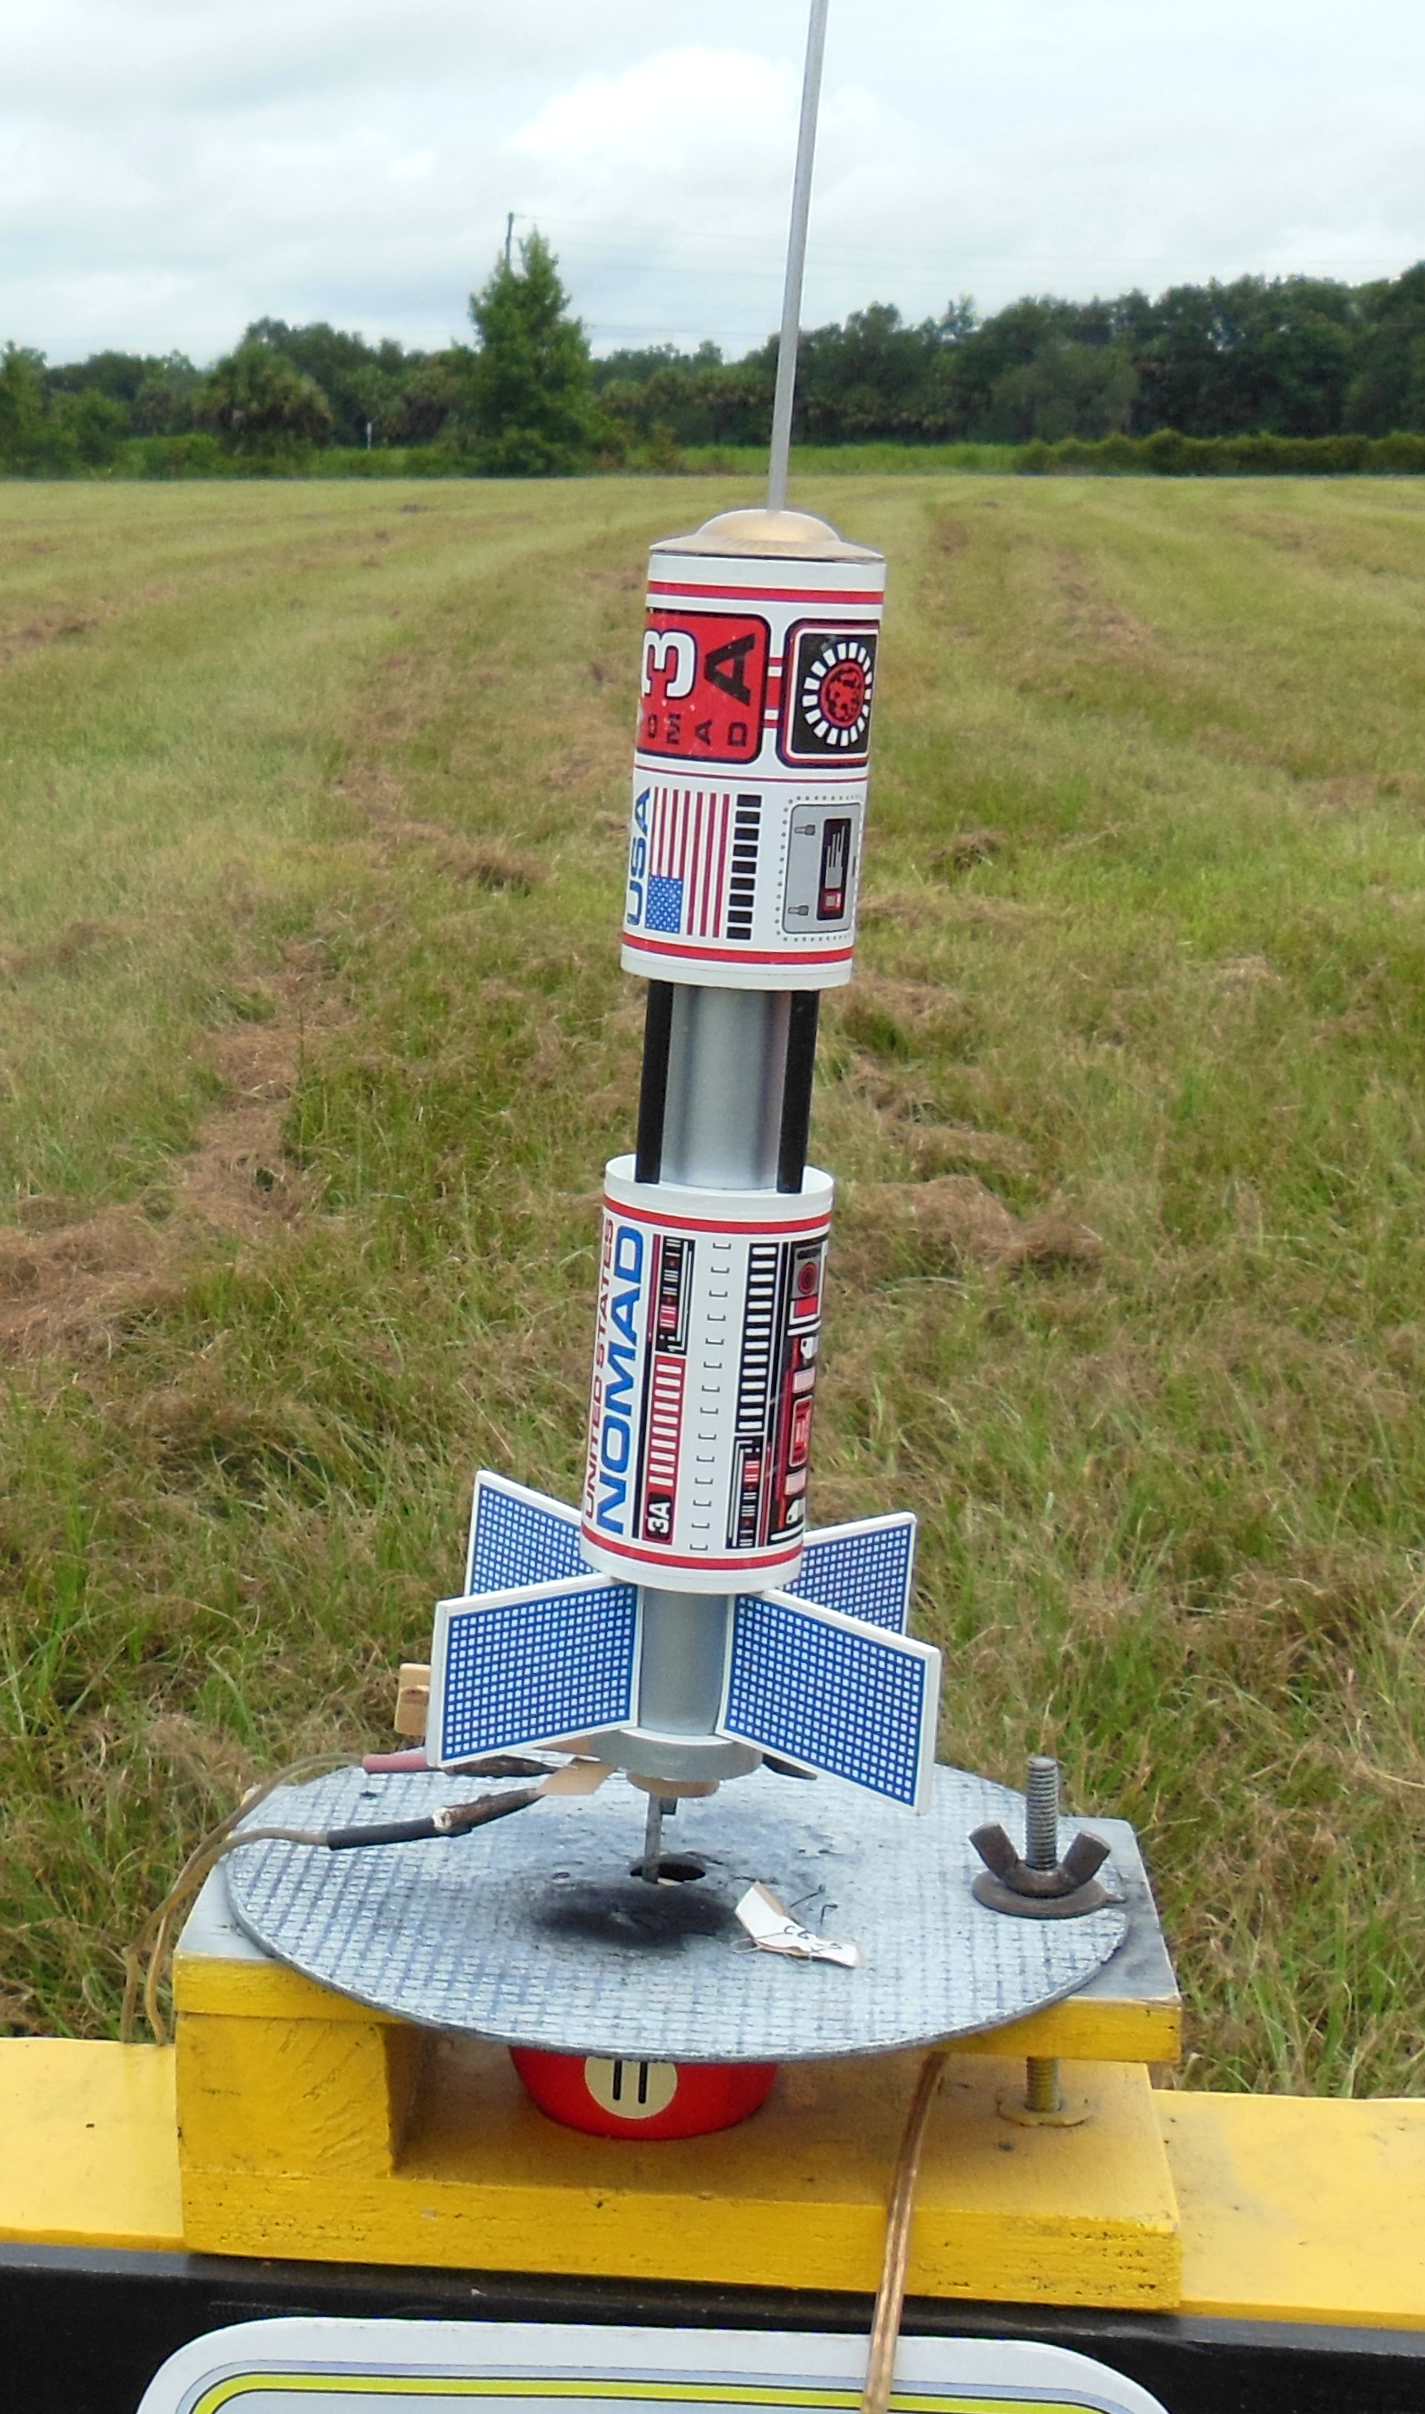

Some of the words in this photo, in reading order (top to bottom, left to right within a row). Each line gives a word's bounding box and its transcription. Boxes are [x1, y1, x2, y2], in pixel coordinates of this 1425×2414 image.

[627, 788, 651, 925] USA
[585, 1375, 605, 1519] UNITED
[597, 1219, 615, 1369] STATES
[597, 1224, 644, 1535] NOMAD
[648, 1501, 671, 1534] 3A
